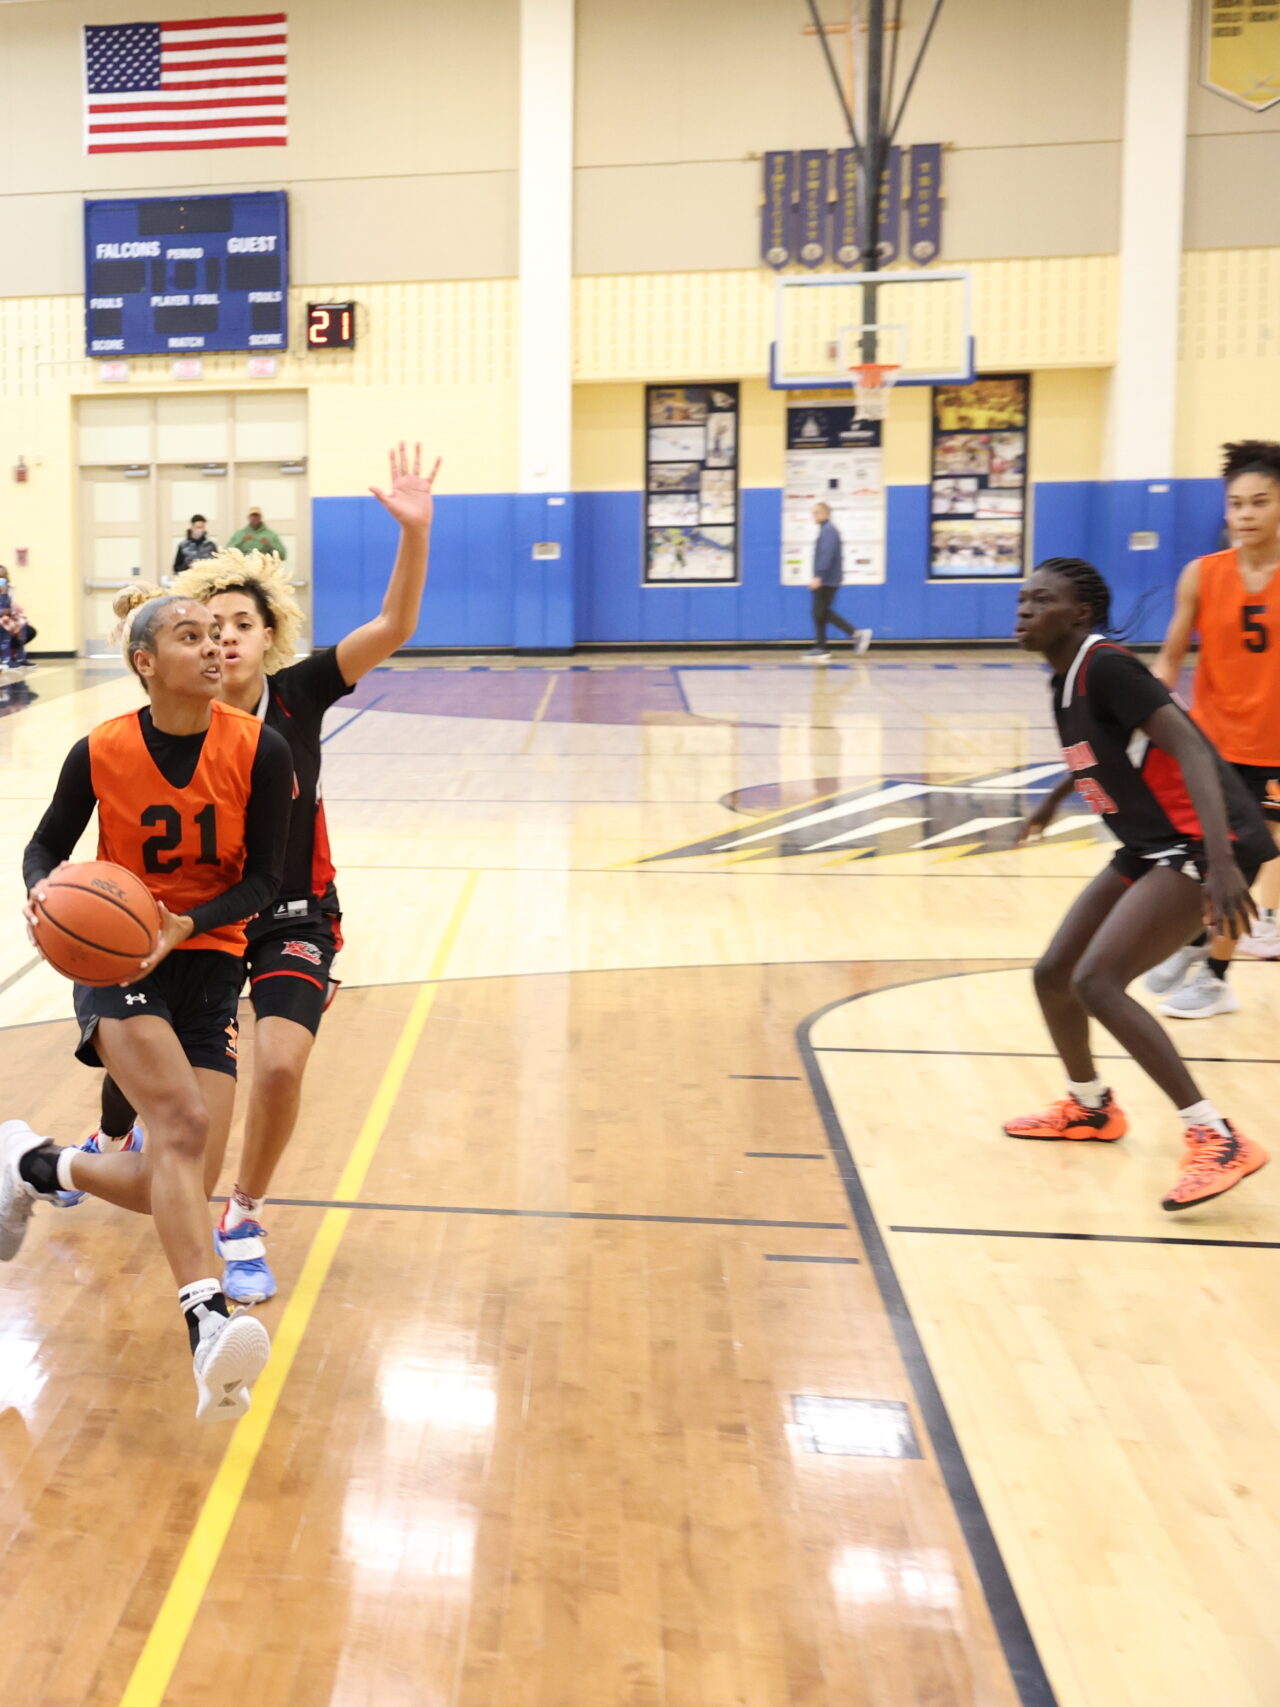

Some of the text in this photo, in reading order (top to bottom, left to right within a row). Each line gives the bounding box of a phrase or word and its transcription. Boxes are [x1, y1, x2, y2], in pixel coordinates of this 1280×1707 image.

[96, 240, 161, 260] FALCONS
[227, 236, 278, 254] GUEST
[310, 311, 349, 342] 21
[1241, 605, 1270, 653] 5
[140, 803, 221, 875] 21
